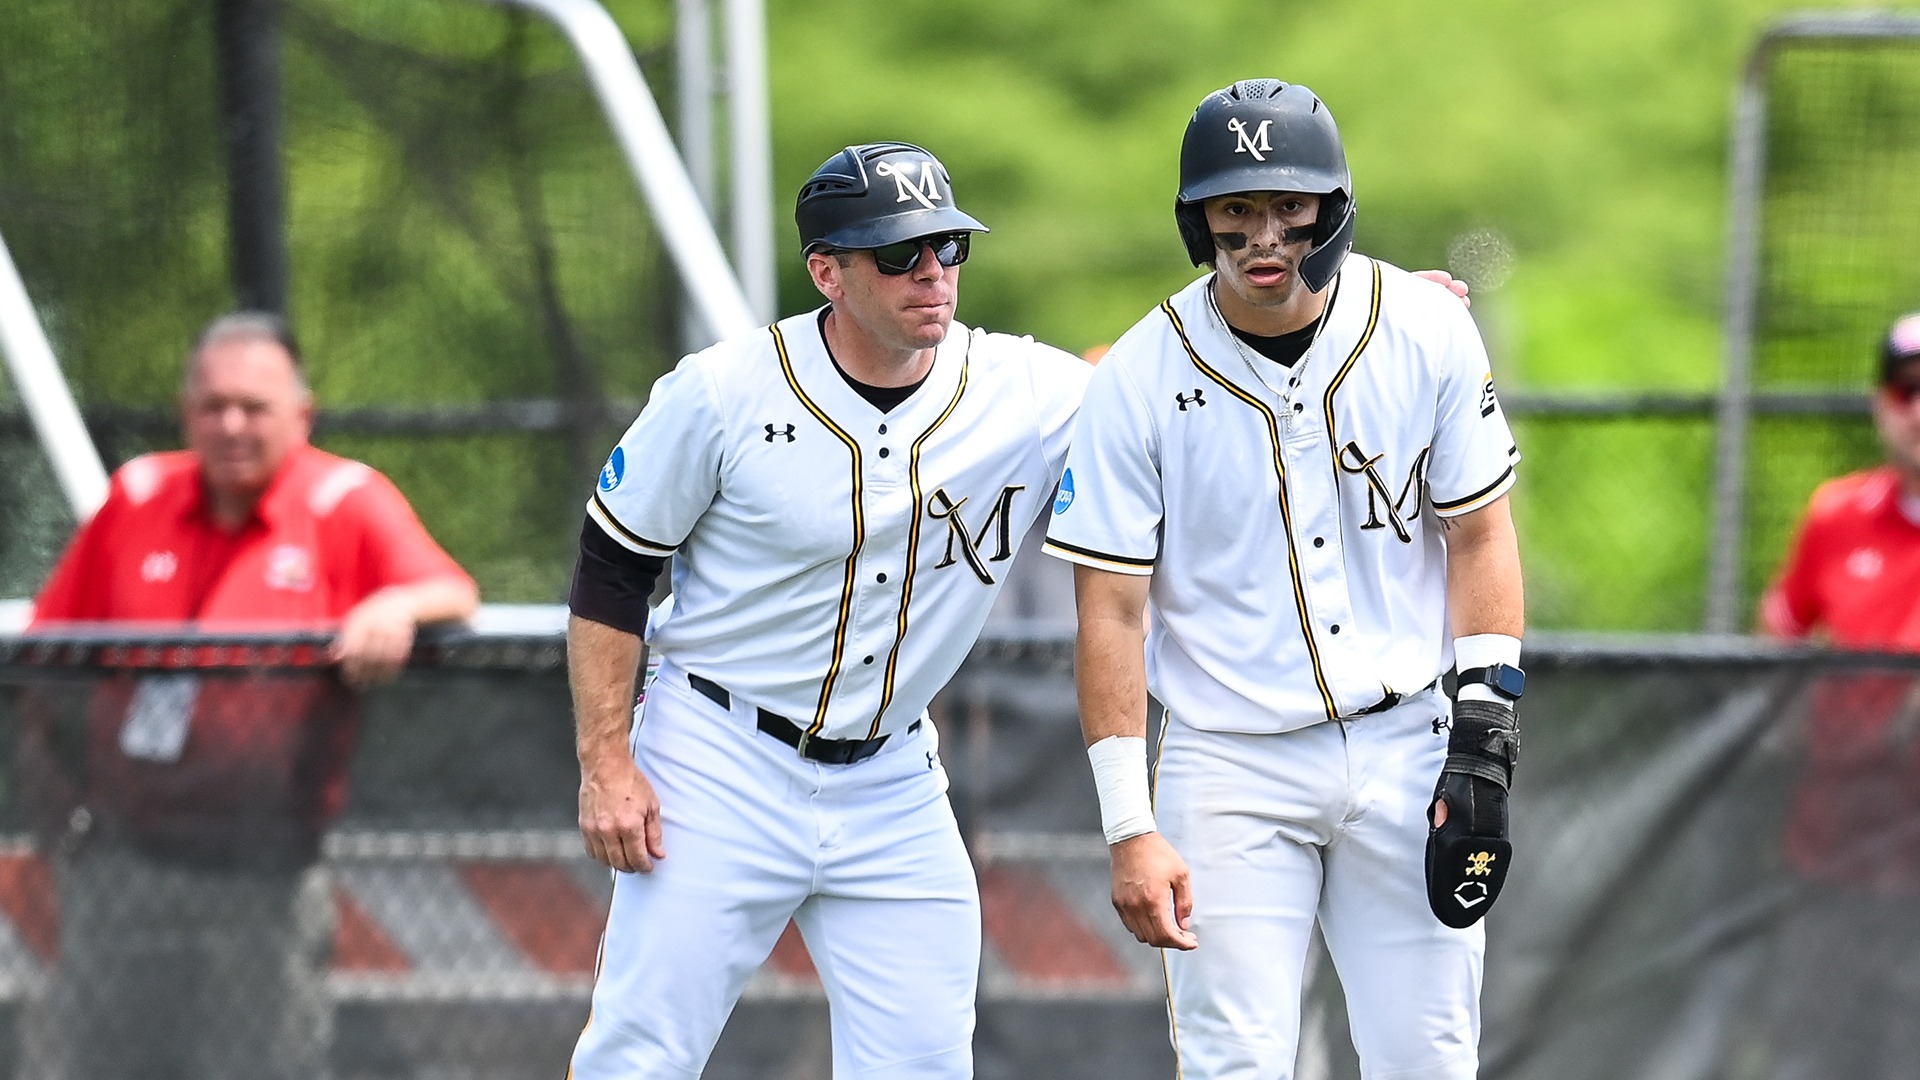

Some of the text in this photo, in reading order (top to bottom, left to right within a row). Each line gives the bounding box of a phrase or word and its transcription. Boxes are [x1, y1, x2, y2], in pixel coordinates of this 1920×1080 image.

[1227, 116, 1274, 162] M
[875, 160, 943, 209] M
[1338, 440, 1431, 544] M
[927, 485, 1026, 586] M
